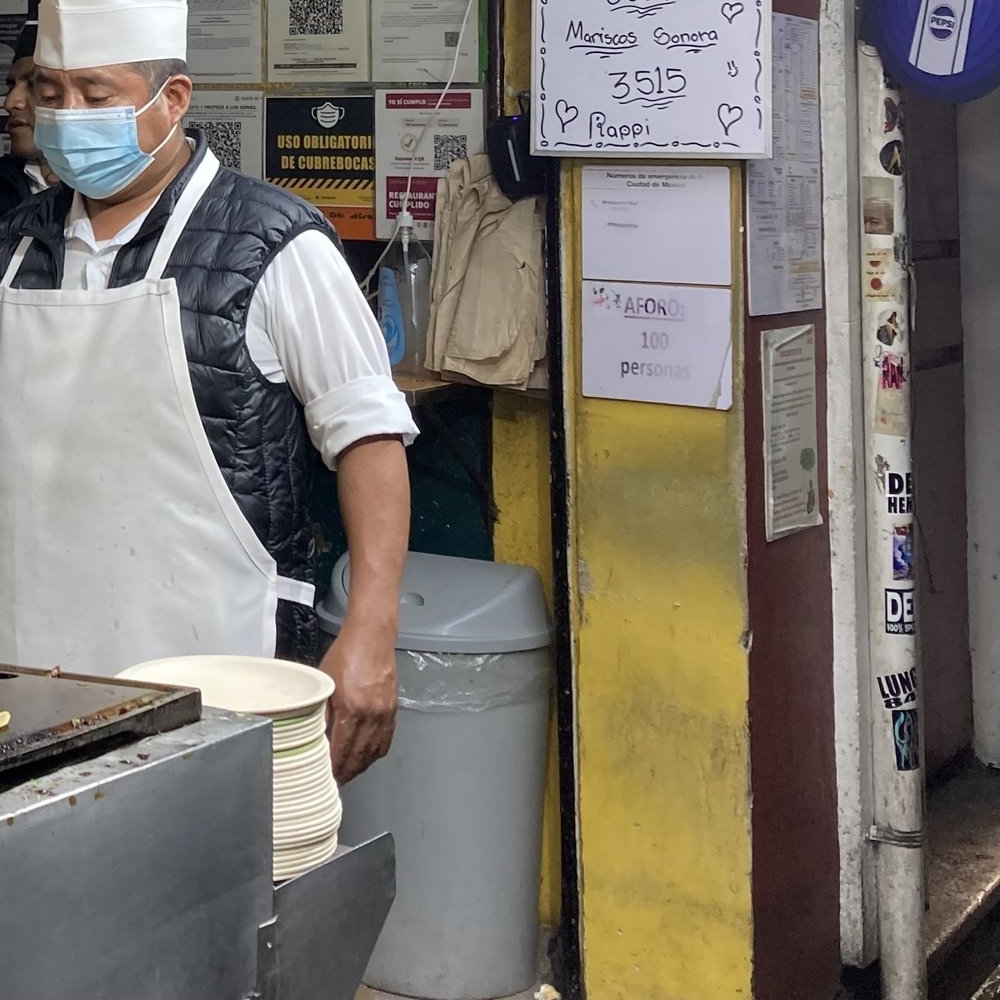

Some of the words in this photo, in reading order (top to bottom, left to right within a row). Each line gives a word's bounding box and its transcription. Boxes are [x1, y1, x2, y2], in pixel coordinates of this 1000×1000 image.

[931, 16, 955, 29] PEPSI
[566, 21, 638, 45] Mariscos
[654, 26, 719, 45] Sonora
[608, 67, 687, 99] 3515
[589, 112, 650, 139] Rappi
[277, 134, 301, 150] USO
[303, 134, 374, 150] OBLIGATORI
[281, 155, 296, 170] DE
[297, 155, 375, 171] CUBREBOCAS
[641, 332, 669, 350] 100
[621, 360, 691, 379] personas
